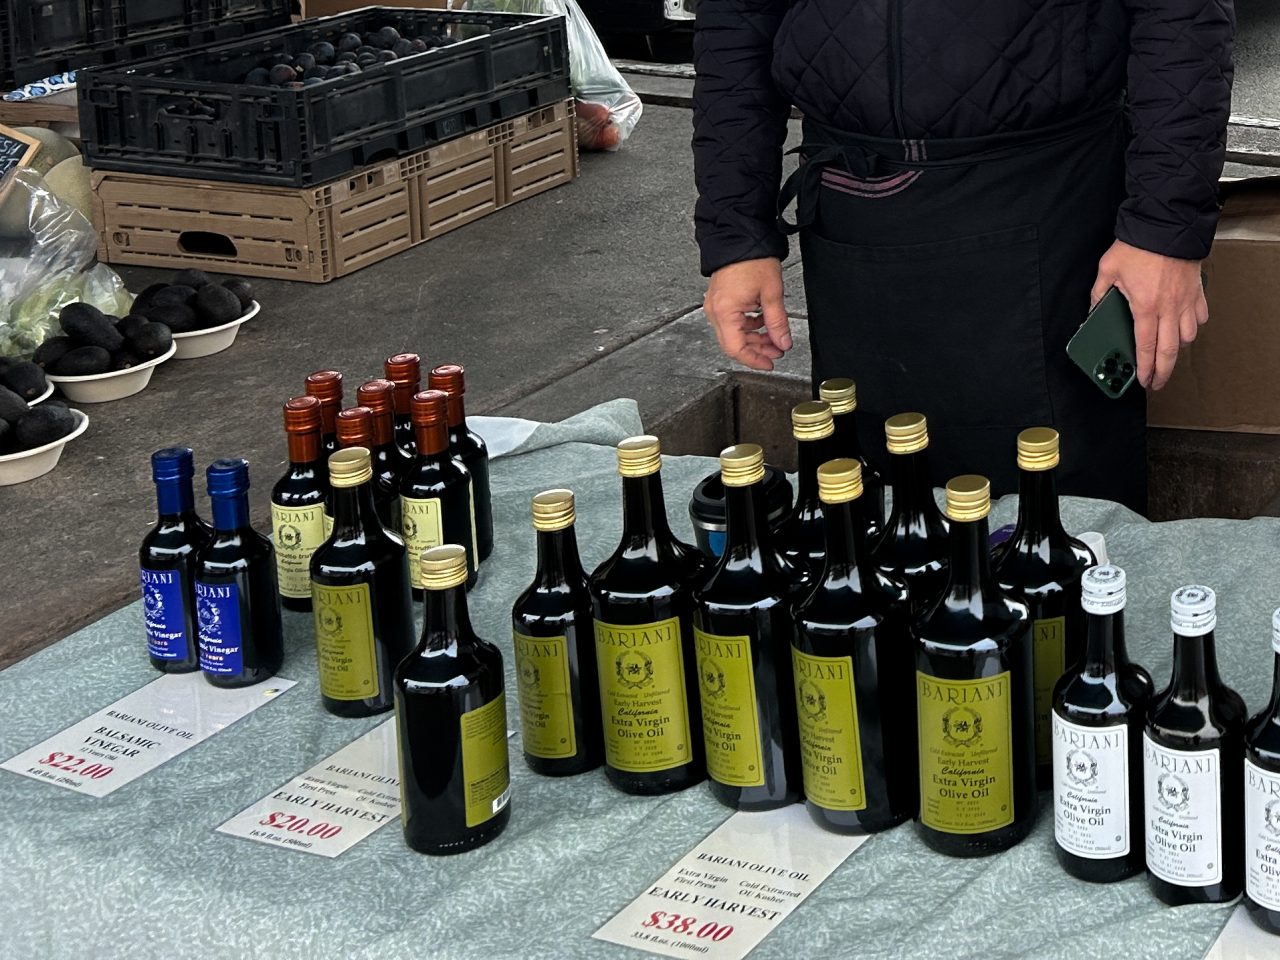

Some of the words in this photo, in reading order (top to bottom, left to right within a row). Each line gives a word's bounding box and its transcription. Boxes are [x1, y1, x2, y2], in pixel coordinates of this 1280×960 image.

[154, 631, 182, 639] Vinegar
[599, 627, 671, 648] BARIANI
[210, 646, 239, 654] Vinegar
[922, 681, 1002, 705] BARIANI
[614, 699, 630, 708] Early
[632, 699, 662, 707] Harvest
[612, 716, 633, 726] Extra
[637, 716, 670, 727] Virgin
[618, 708, 658, 718] California
[106, 710, 148, 728] BARIANI
[146, 721, 179, 735] OLIVE
[176, 729, 194, 740] OIL
[617, 729, 643, 738] Olive
[647, 728, 664, 737] Oil
[94, 726, 161, 749] BALSAMIC
[714, 728, 741, 741] Virgin
[1054, 721, 1119, 749] BARIANI
[83, 736, 141, 758] VINEGAR
[722, 743, 736, 751] Oil
[39, 751, 113, 779] $22.00
[814, 752, 842, 765] Virgin
[937, 757, 955, 767] Early
[958, 757, 989, 766] Harvest
[1146, 744, 1211, 774] BARIANI
[326, 764, 370, 783] BARIANI
[822, 766, 837, 775] Oil
[941, 767, 985, 777] California
[299, 782, 317, 792] First
[933, 775, 957, 787] Extra
[961, 775, 996, 787] Virgin
[939, 788, 967, 799] Olive
[971, 787, 989, 798] Oil
[1067, 791, 1098, 803] California
[273, 792, 324, 809] EARLY
[322, 801, 390, 823] HARVEST
[1060, 795, 1077, 811] Extra
[1080, 804, 1111, 817] Virgin
[259, 811, 343, 840] $20.00
[1063, 809, 1086, 824] Olive
[1088, 817, 1104, 826] Oil
[1158, 816, 1189, 828] California
[1151, 820, 1169, 836] Extra
[1172, 830, 1203, 843] Virgin
[1155, 834, 1177, 850] Olive
[1180, 843, 1196, 852] Oil
[1256, 849, 1277, 865] Extra
[697, 852, 749, 870] BARIANI
[749, 862, 787, 877] OLIVE
[788, 871, 811, 882] OIL
[674, 876, 694, 886] First
[695, 881, 717, 890] Press
[754, 892, 785, 904] Kosher
[678, 868, 702, 879] Extra
[701, 871, 729, 884] Virgin
[739, 880, 759, 890] Cold
[759, 884, 801, 898] Extracted
[649, 887, 703, 904] EARLY
[703, 897, 782, 921] HARVEST
[642, 910, 734, 942] $38.00
